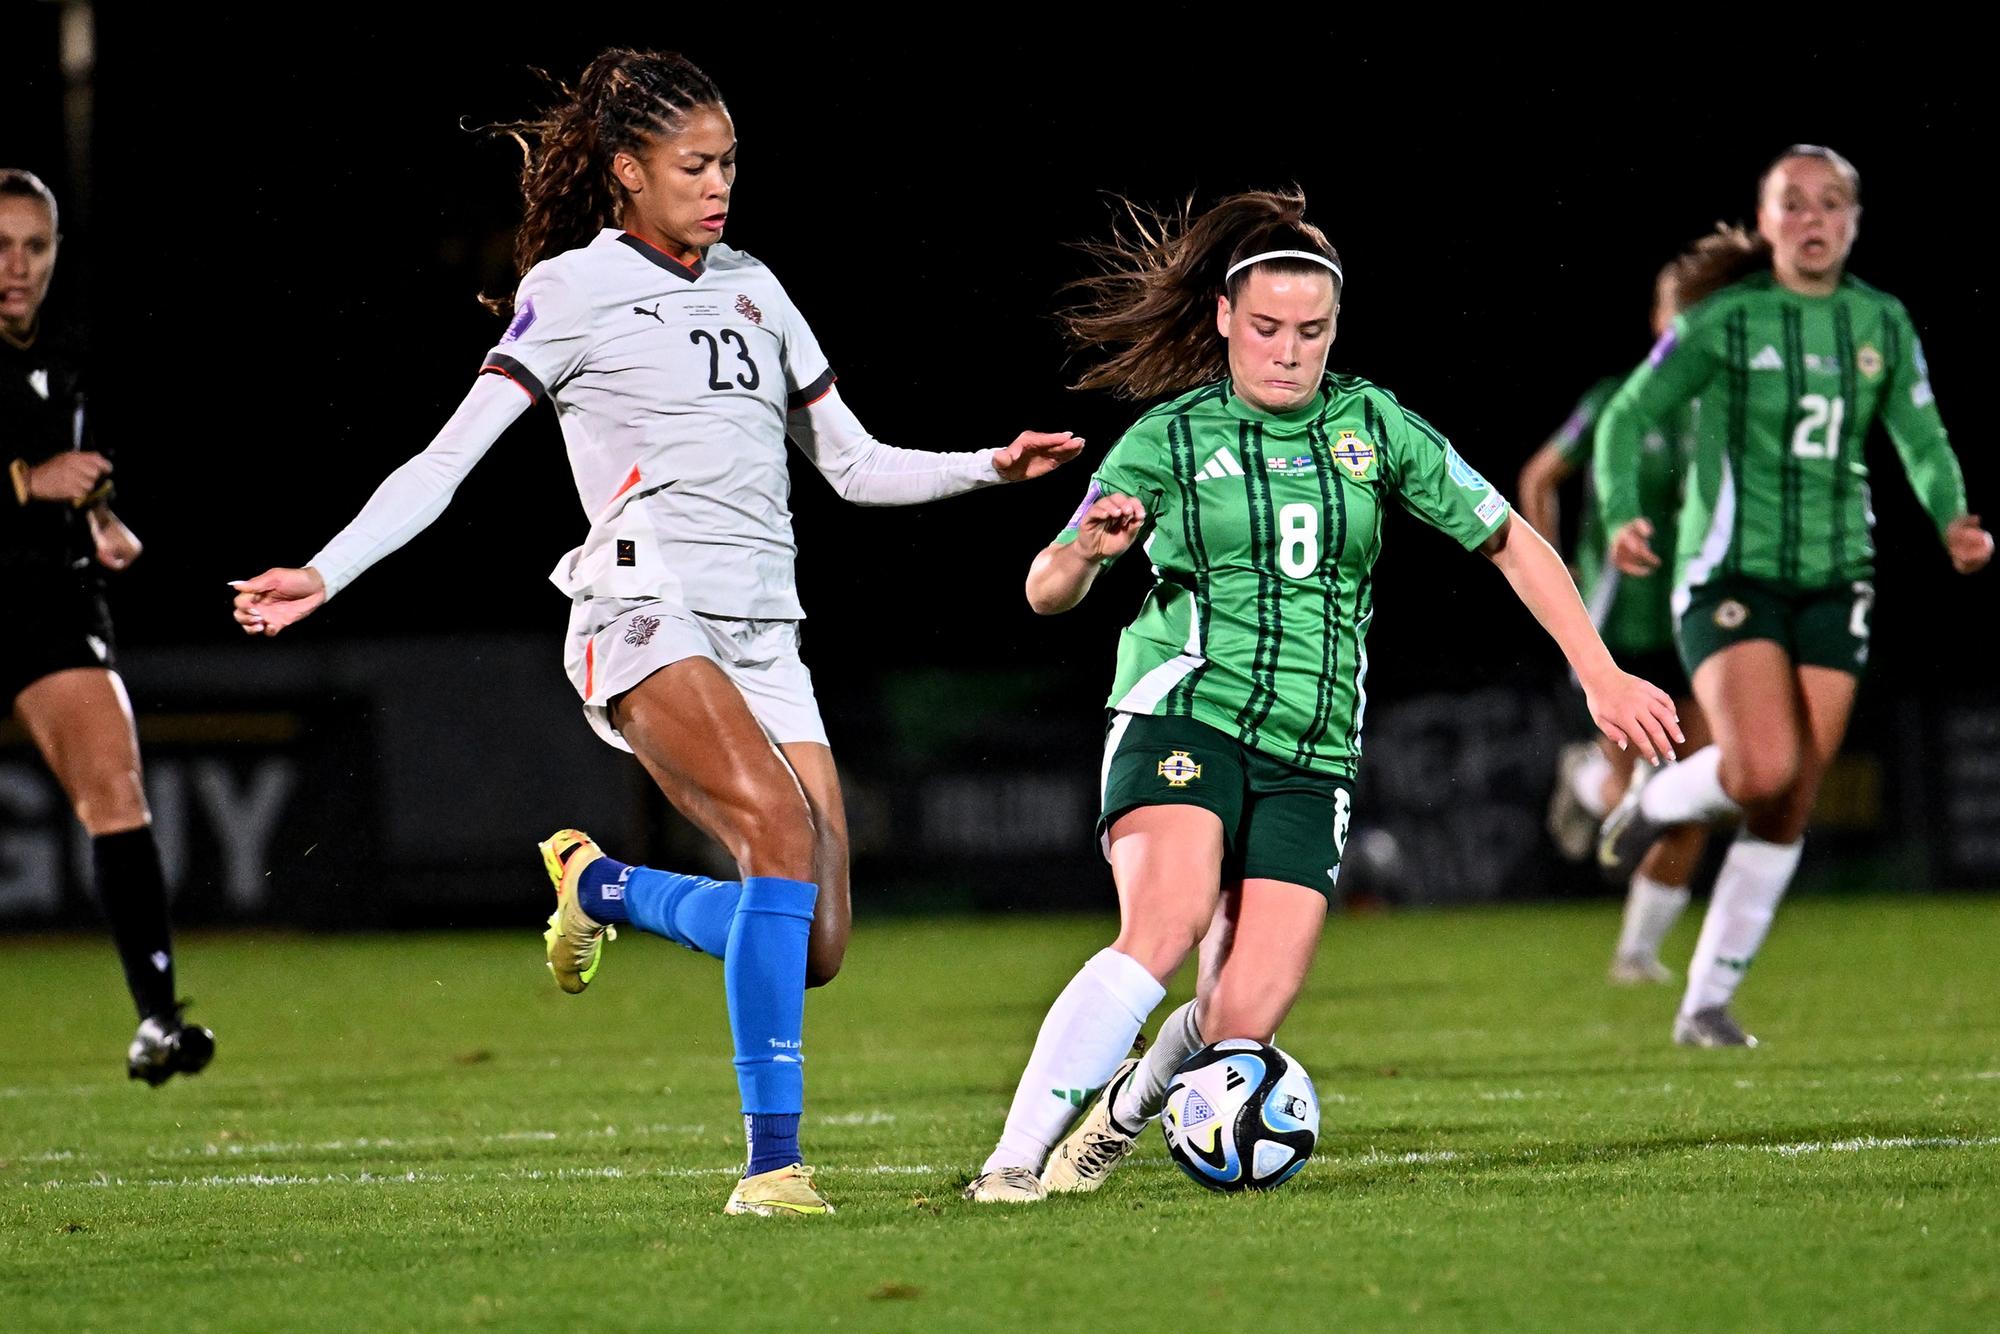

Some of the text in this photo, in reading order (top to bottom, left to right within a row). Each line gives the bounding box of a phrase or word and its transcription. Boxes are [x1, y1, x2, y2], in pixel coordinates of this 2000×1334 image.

[690, 328, 760, 391] 23
[1791, 394, 1845, 460] 21
[1279, 503, 1318, 579] 8
